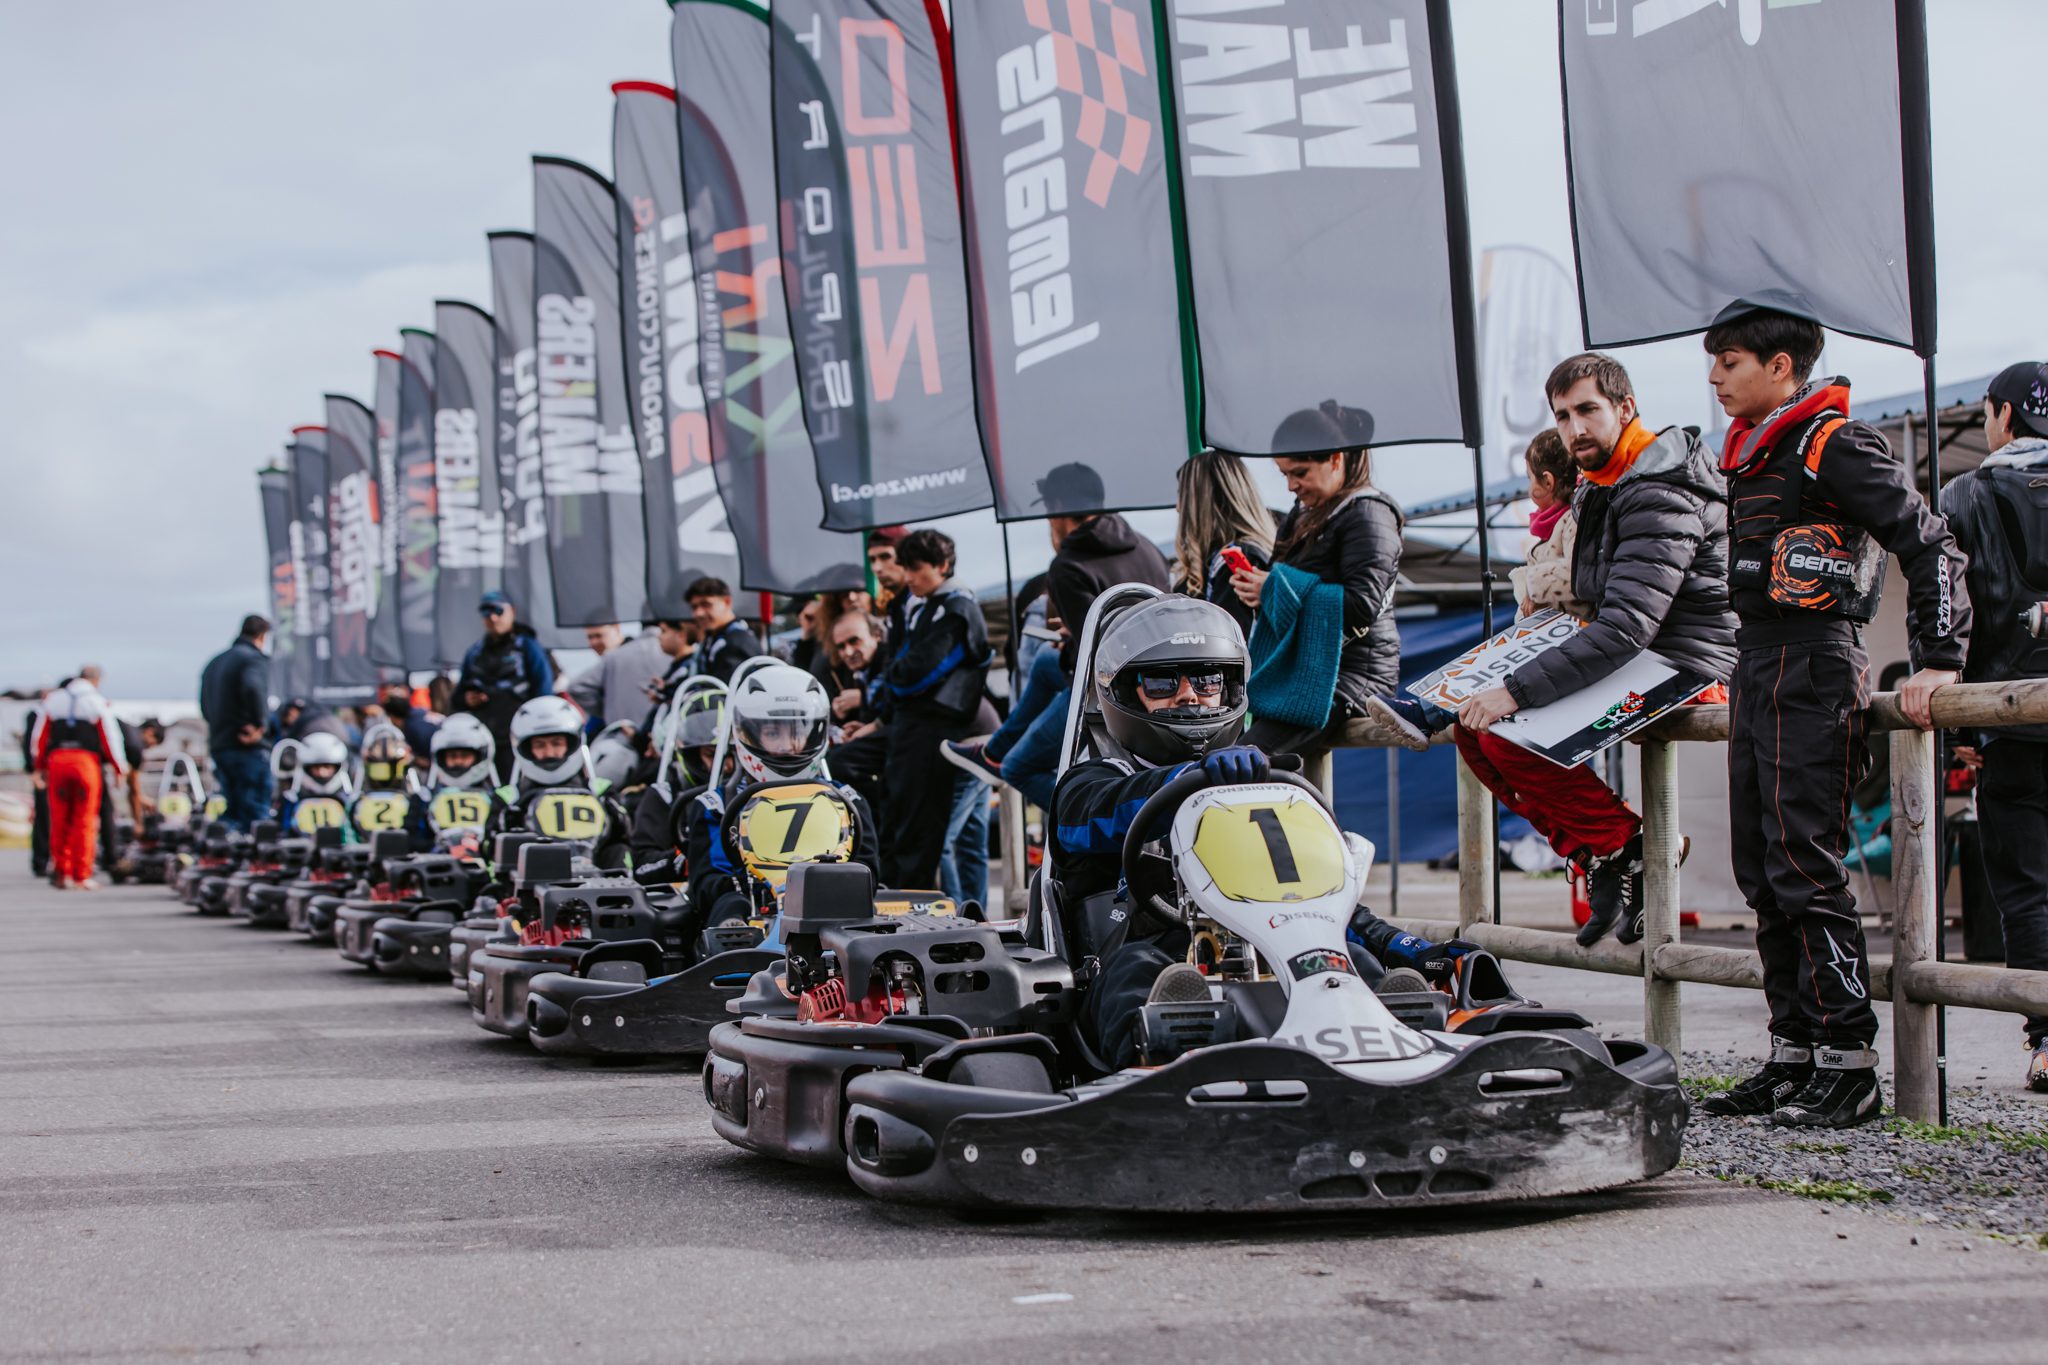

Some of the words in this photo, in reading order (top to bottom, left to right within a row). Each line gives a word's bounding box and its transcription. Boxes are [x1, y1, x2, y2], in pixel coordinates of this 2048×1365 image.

[373, 802, 393, 823] 2
[447, 798, 478, 823] 15
[775, 802, 814, 854] 7
[1249, 808, 1301, 884] 1
[1822, 1053, 1843, 1064] OMP
[1773, 1082, 1795, 1097] OMP
